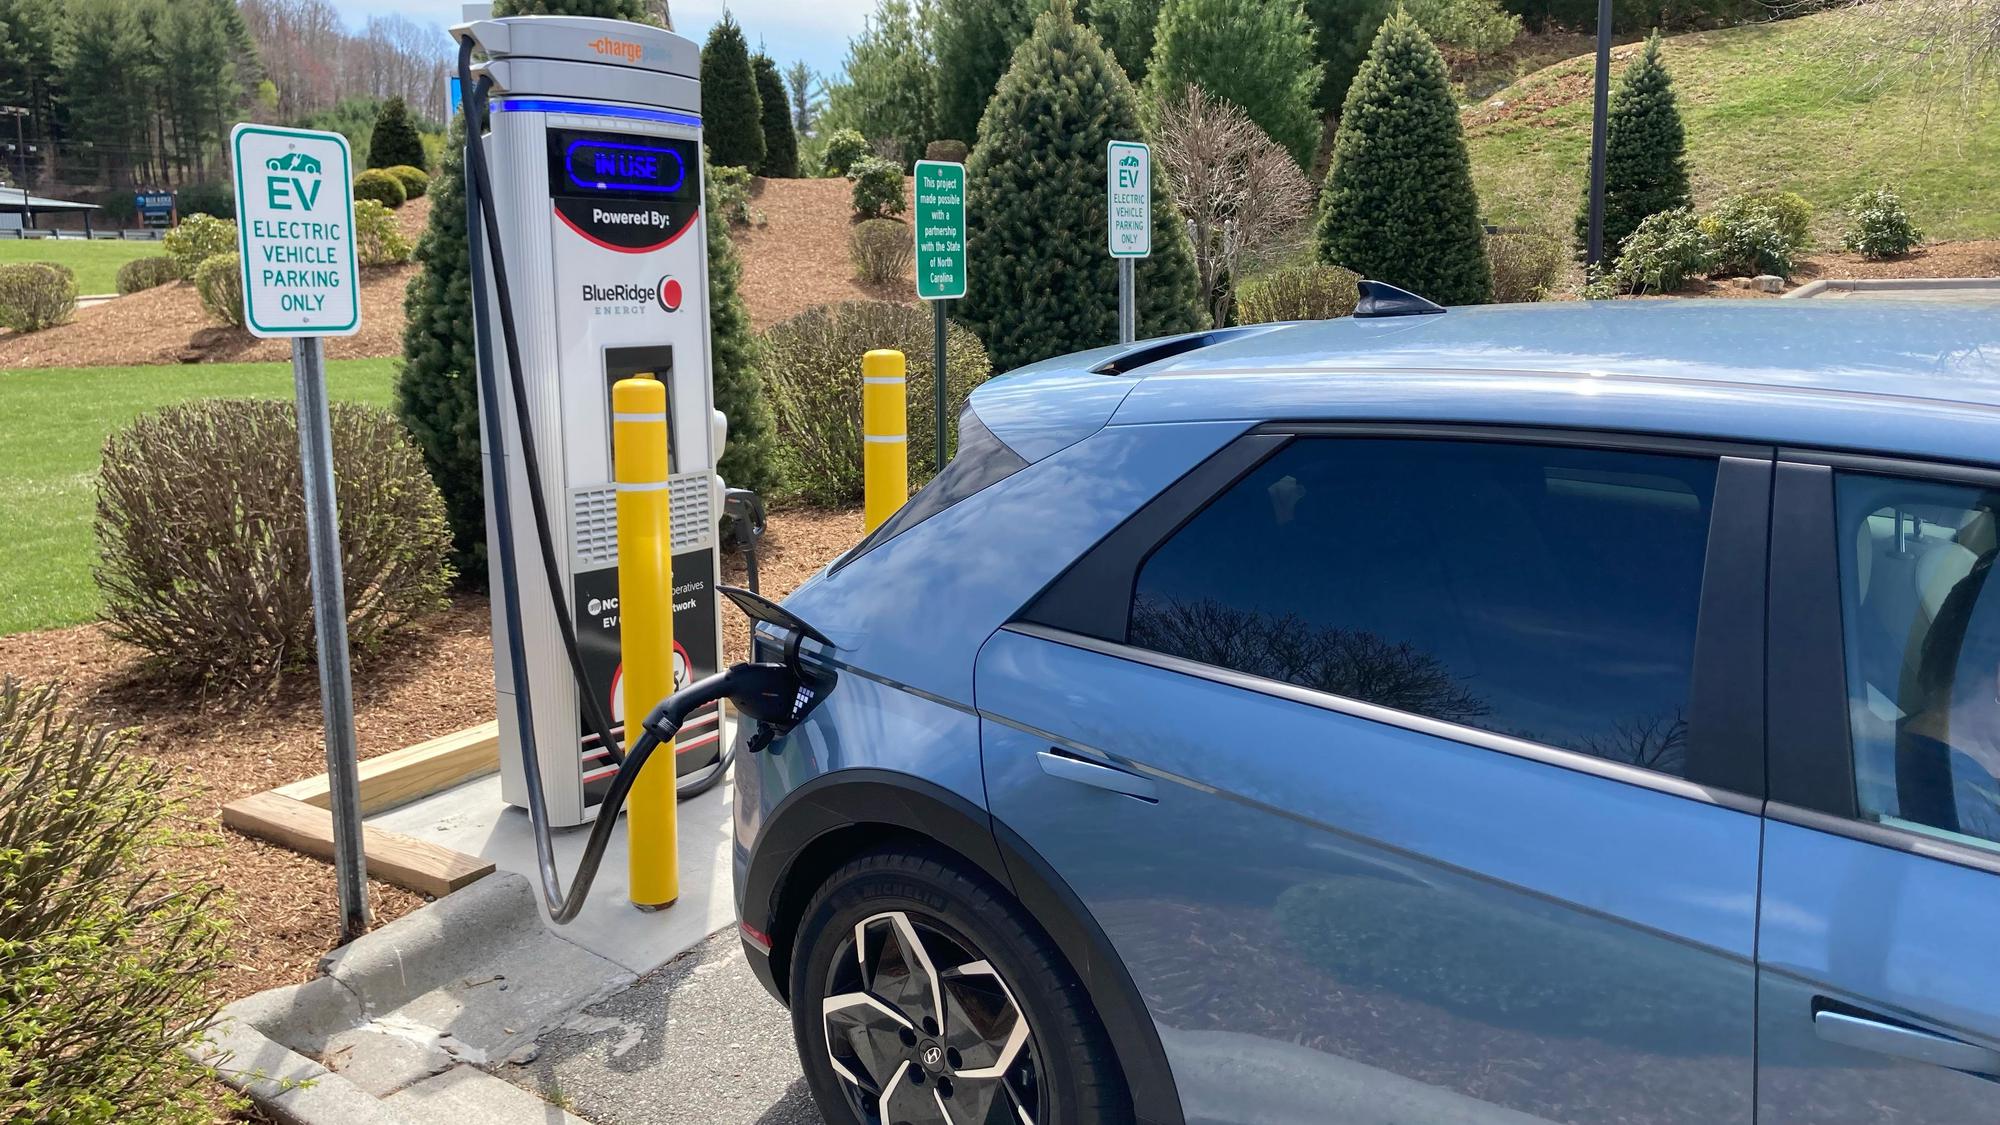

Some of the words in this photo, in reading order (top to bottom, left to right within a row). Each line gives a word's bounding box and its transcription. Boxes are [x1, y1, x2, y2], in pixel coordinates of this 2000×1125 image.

[595, 152, 615, 176] IN
[620, 153, 656, 178] USE
[924, 177, 935, 188] This
[937, 179, 956, 191] project
[1119, 169, 1138, 188] EV
[267, 176, 322, 211] EV
[1114, 194, 1144, 204] ELECTRIC
[920, 194, 936, 204] made
[938, 194, 960, 206] possible
[593, 208, 648, 225] Powered
[651, 211, 670, 228] By:
[932, 210, 944, 220] with
[946, 211, 949, 220] a
[1116, 207, 1143, 217] VEHICLE
[254, 221, 340, 240] ELECTRIC
[1116, 221, 1144, 230] PARKING
[925, 226, 956, 238] partnership
[1122, 234, 1138, 244] ONLY
[921, 242, 934, 252] with
[936, 242, 945, 251] the
[947, 241, 960, 251] State
[263, 245, 338, 264] VEHICLE
[930, 257, 936, 267] of
[938, 257, 952, 267] North
[264, 270, 340, 287] PARKING
[930, 273, 953, 283] Carolina
[582, 284, 655, 303] BlueRidge
[281, 294, 325, 311] ONLY
[595, 306, 646, 315] ENERGY
[602, 598, 618, 610] NC
[603, 616, 617, 628] EV
[672, 598, 696, 612] twork
